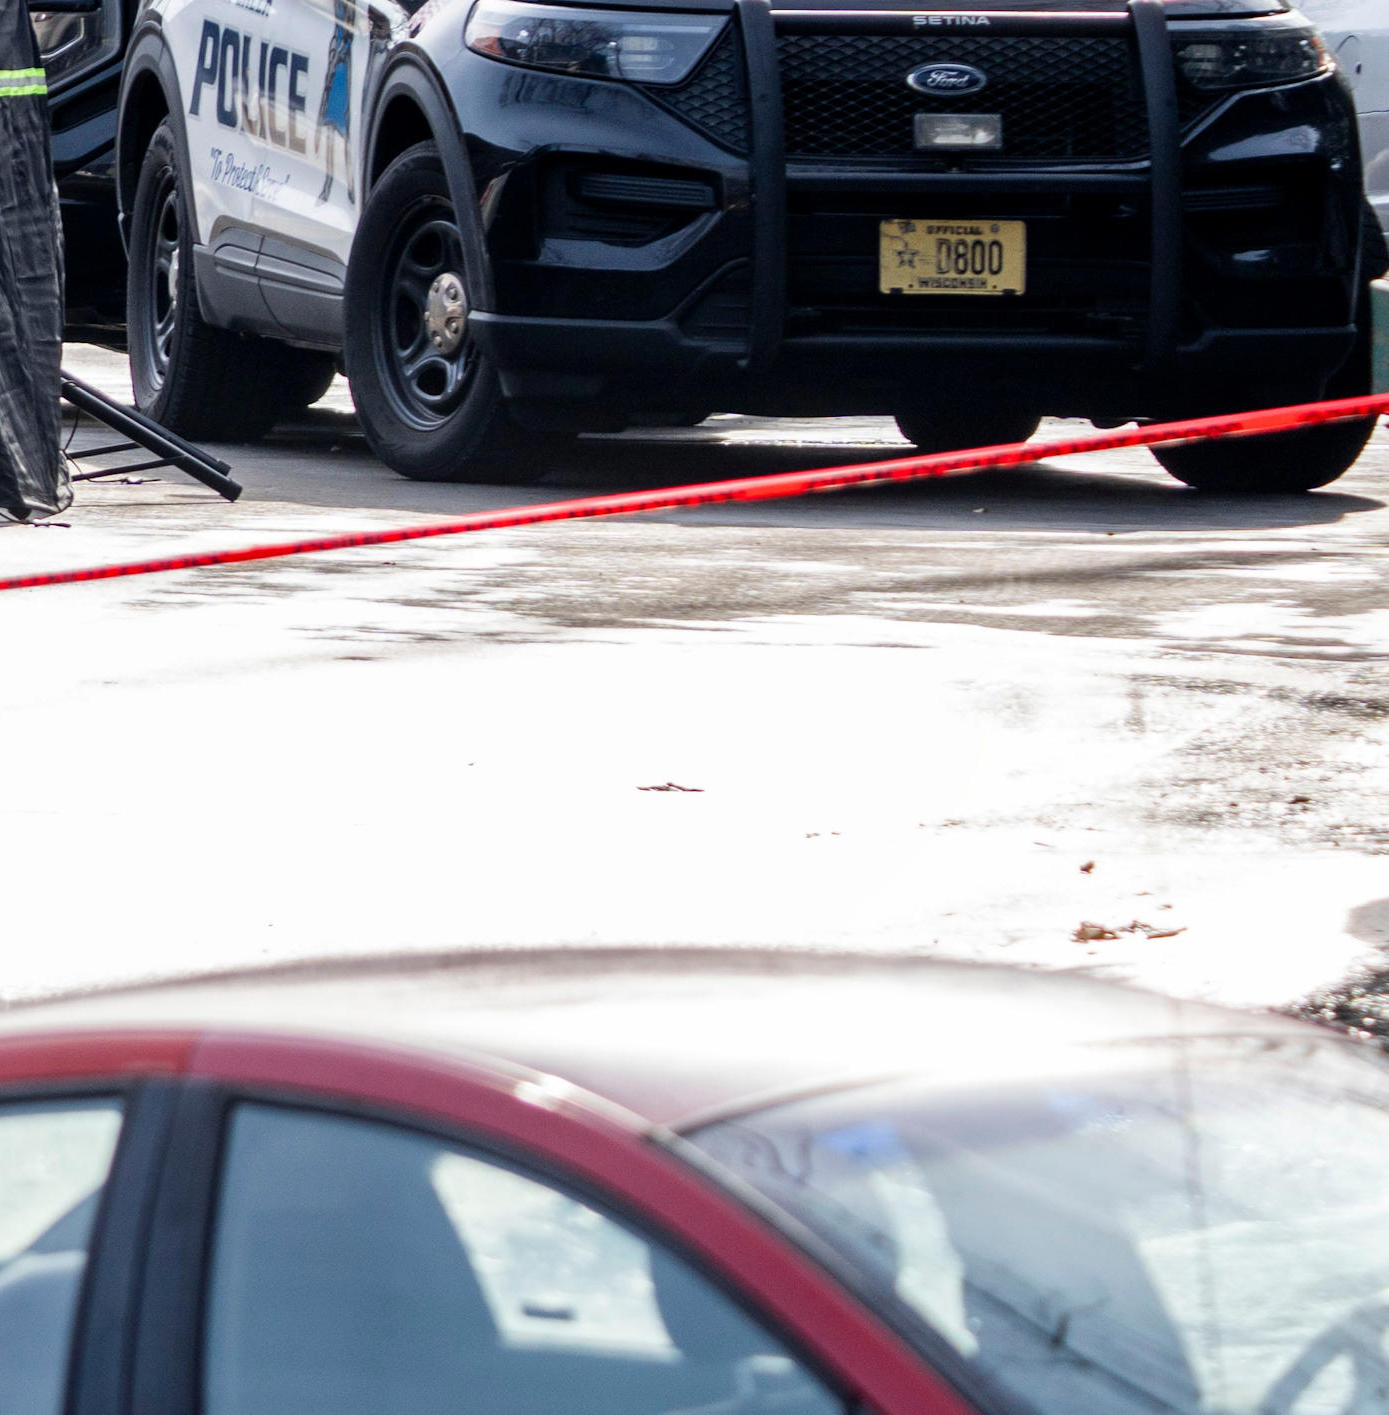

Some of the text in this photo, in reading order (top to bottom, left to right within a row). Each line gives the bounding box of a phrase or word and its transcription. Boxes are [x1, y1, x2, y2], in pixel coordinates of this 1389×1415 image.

[912, 15, 990, 26] SETINA
[188, 17, 310, 155] POLICE
[926, 69, 970, 87] Ford
[935, 238, 1003, 275] D800
[918, 277, 987, 289] WISCONSIN
